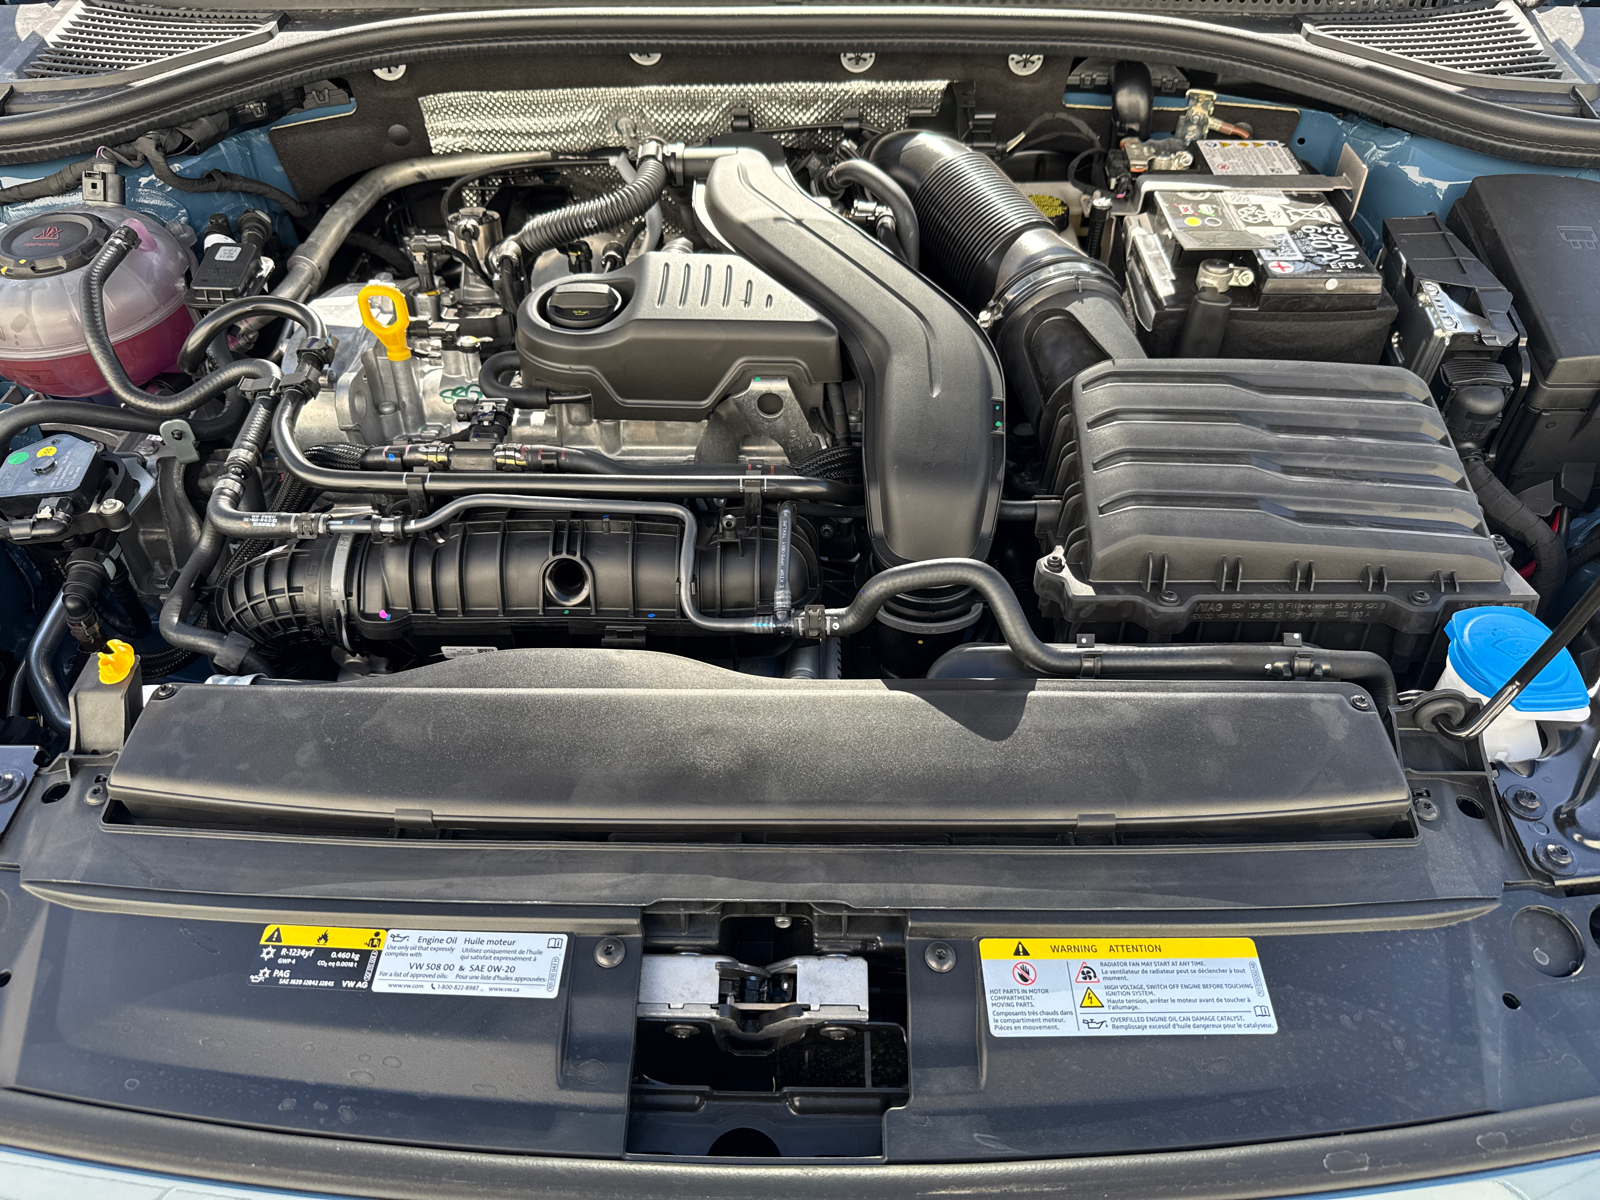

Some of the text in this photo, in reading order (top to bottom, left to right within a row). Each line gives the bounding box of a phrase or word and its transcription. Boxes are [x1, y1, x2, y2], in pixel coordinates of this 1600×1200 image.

[1301, 225, 1332, 248] 640
[1317, 251, 1340, 261] A
[1323, 226, 1359, 260] 59Ah
[418, 936, 444, 945] Engine
[1050, 944, 1162, 953] WARNING ATTENTION
[281, 948, 314, 958] R-1234yf
[351, 952, 360, 961] kg
[273, 969, 290, 978] PAG
